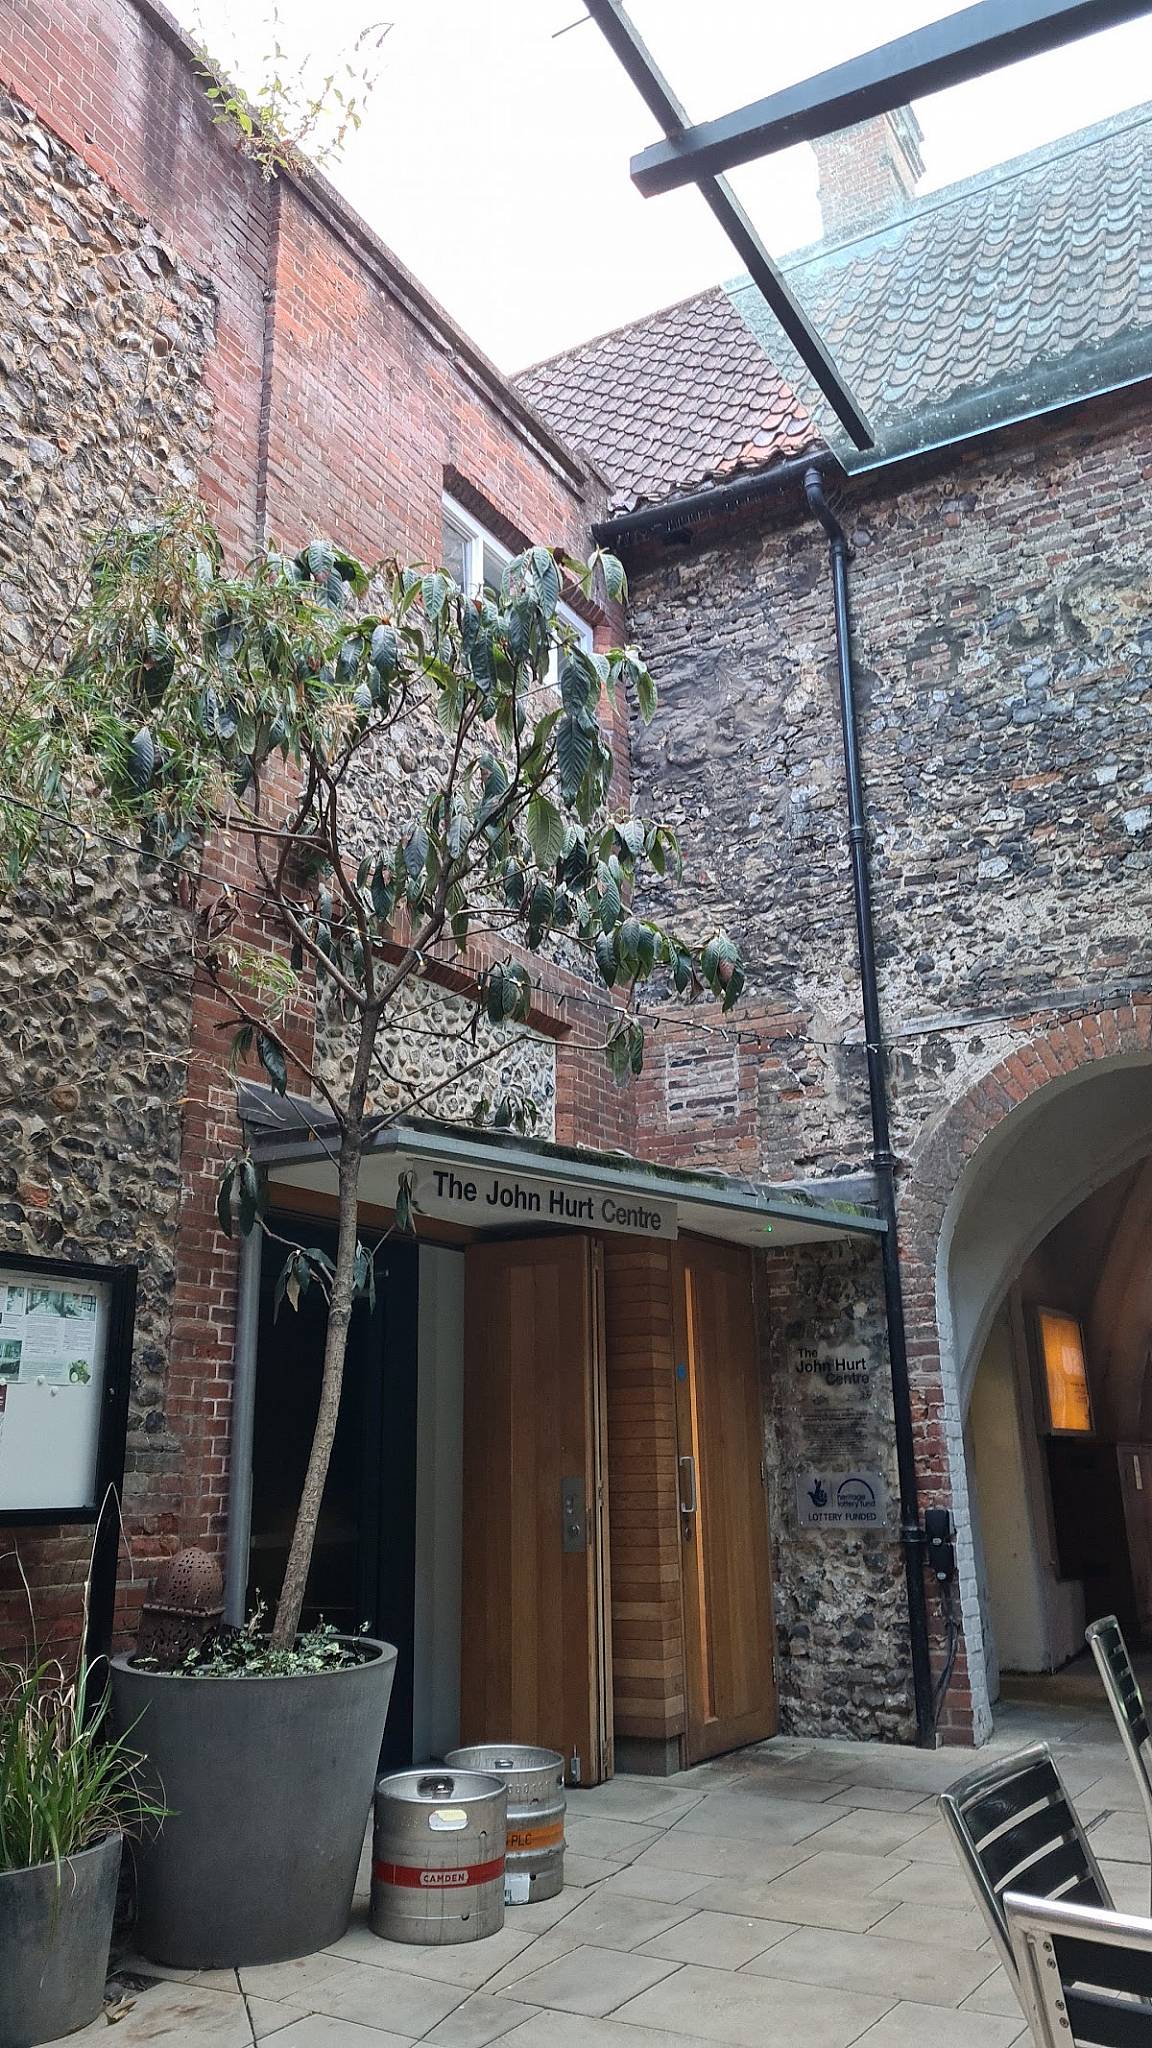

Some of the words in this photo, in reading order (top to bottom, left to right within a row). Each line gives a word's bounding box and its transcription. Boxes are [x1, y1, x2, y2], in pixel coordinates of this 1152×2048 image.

[433, 1170, 477, 1201] The
[486, 1180, 541, 1212] John
[550, 1190, 594, 1220] Hurt
[602, 1198, 662, 1230] Centre
[798, 1347, 818, 1358] The
[796, 1360, 831, 1373] John
[835, 1358, 867, 1371] Hurt
[826, 1372, 869, 1386] Centre
[808, 1512, 842, 1521] LOTTERY
[845, 1512, 877, 1521] FUNDED
[511, 1833, 532, 1847] PLC
[423, 1873, 465, 1883] CAMDEN
